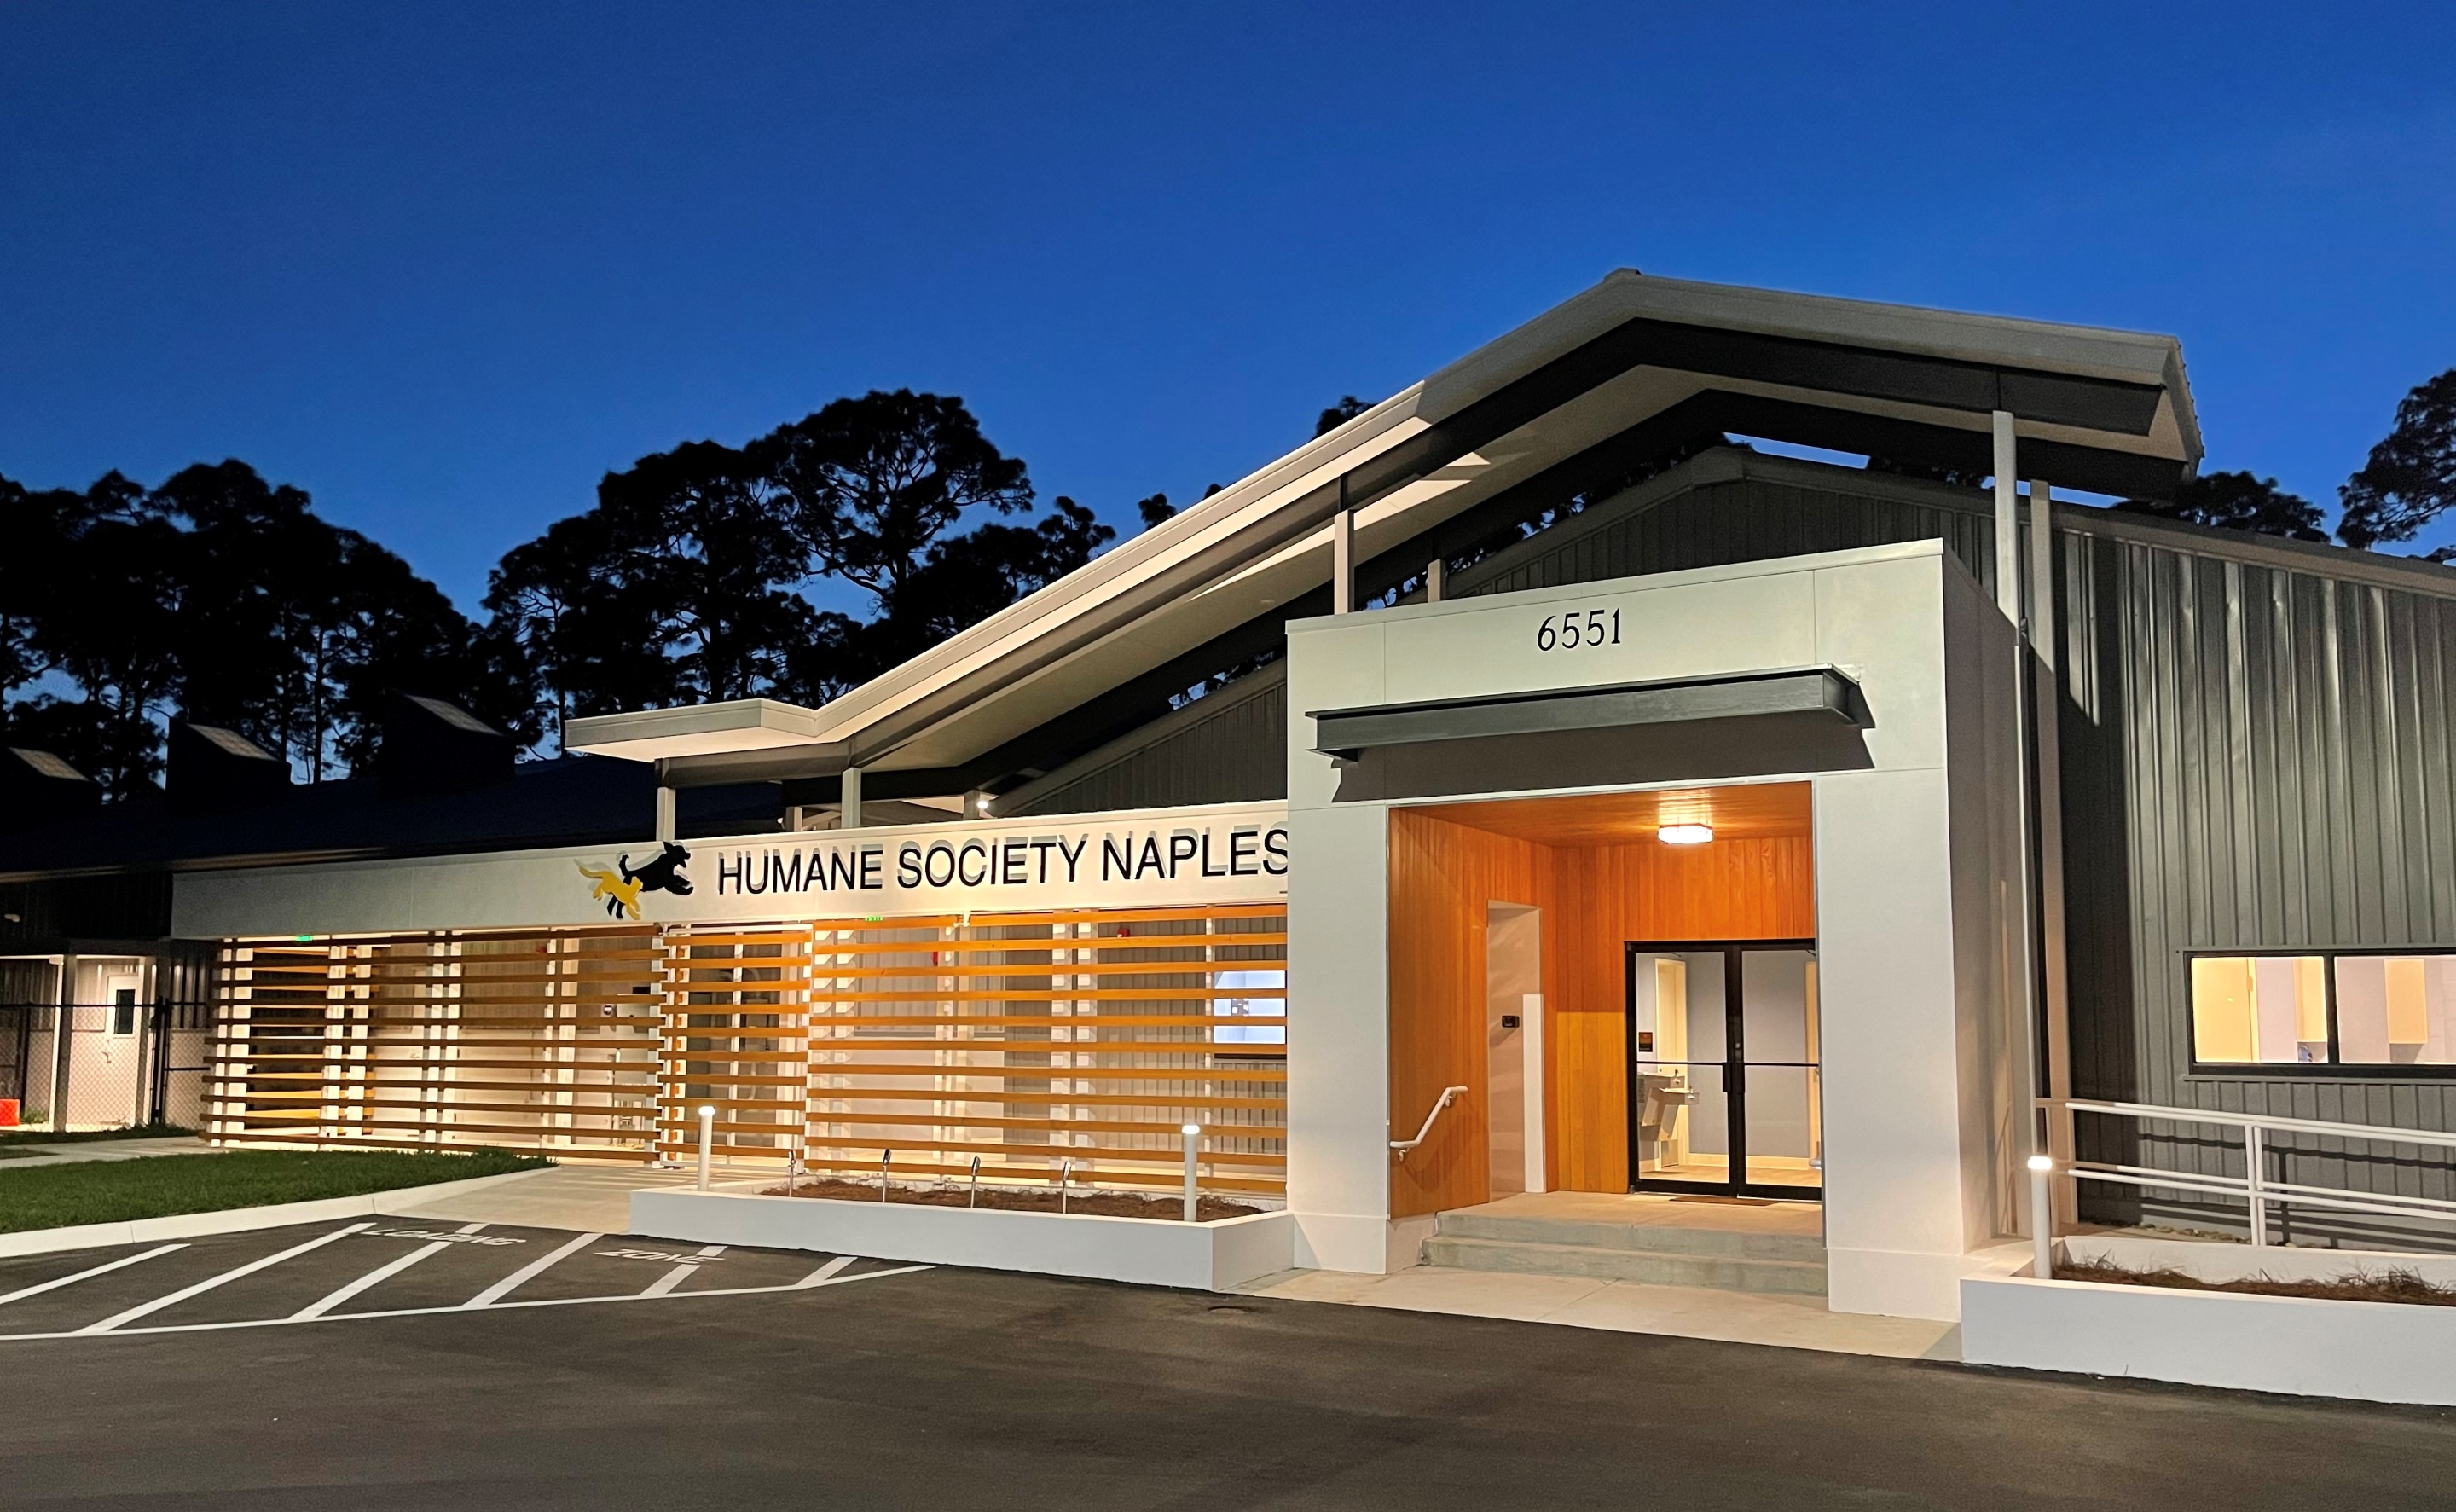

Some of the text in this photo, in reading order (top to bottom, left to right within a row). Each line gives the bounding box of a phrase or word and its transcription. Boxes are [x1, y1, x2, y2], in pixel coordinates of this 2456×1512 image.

[1537, 606, 1621, 652] 6551
[718, 828, 1288, 895] HUMANE SOCIETY NAPLES
[360, 1228, 725, 1264] LOADING ZONE
